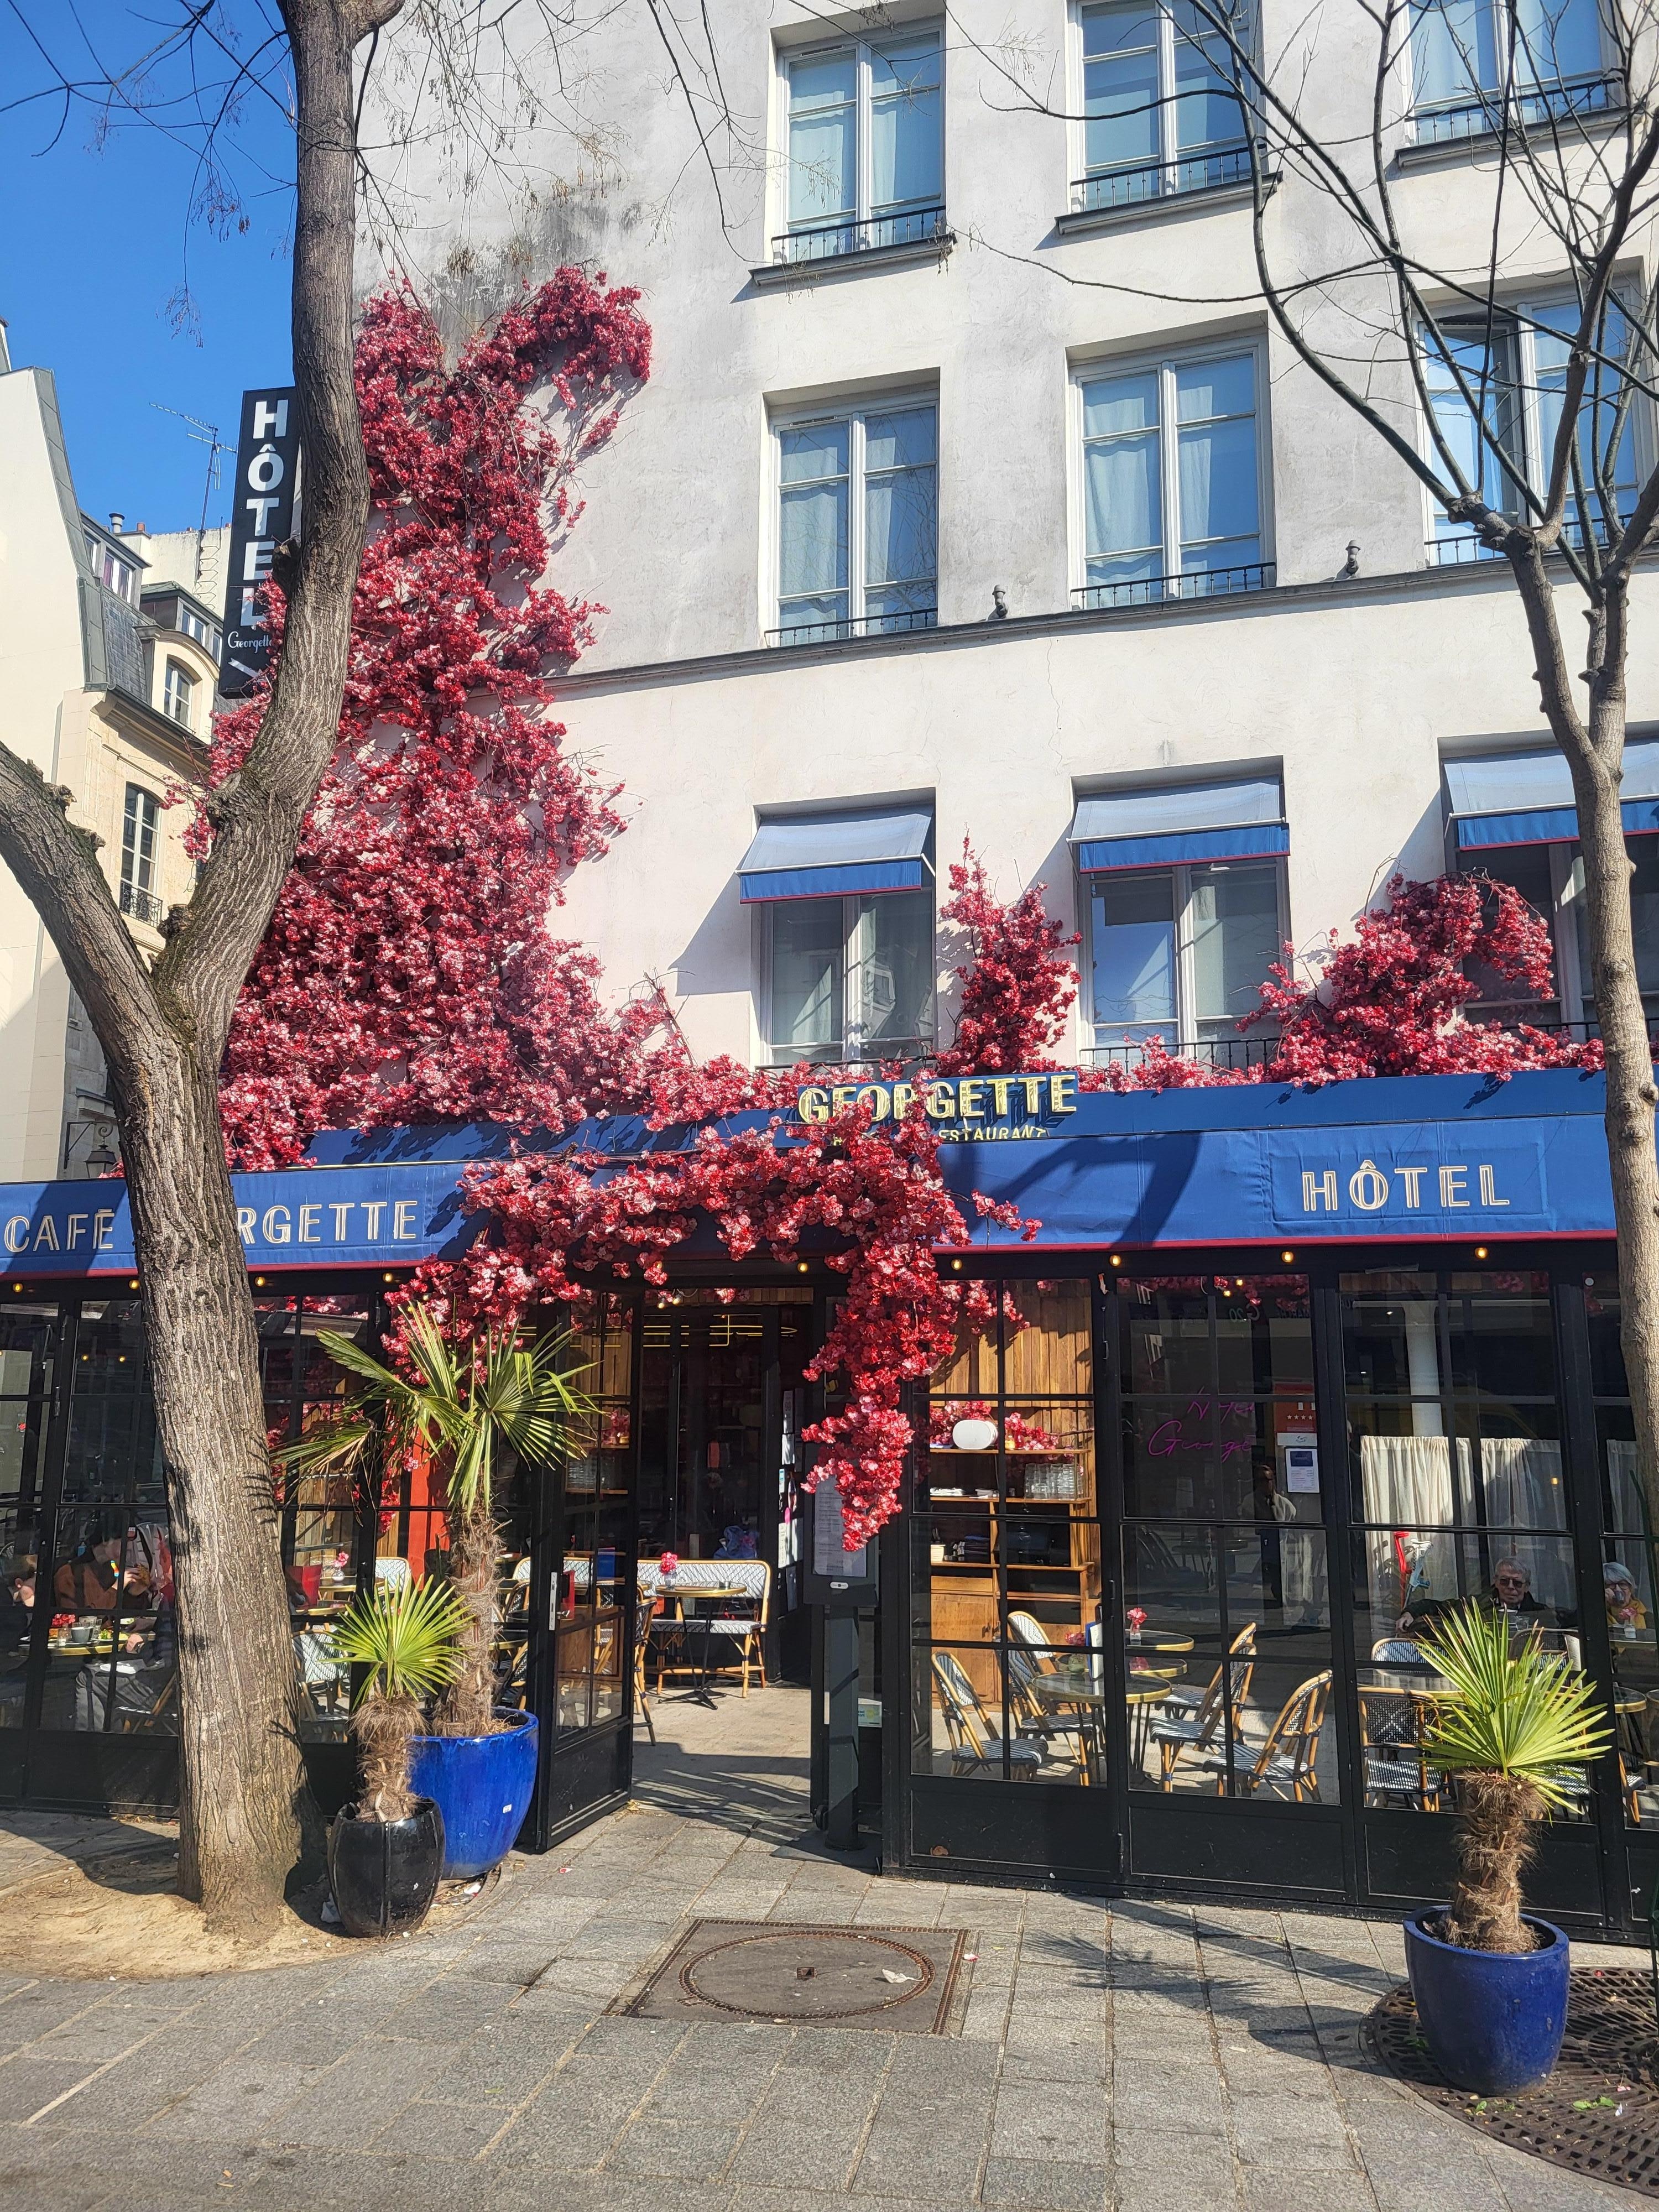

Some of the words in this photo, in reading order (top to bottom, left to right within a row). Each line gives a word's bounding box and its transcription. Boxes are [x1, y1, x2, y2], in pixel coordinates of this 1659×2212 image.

[240, 399, 288, 626] HÔTEL
[938, 1124, 1046, 1141] ESTAURANT
[1302, 1160, 1510, 1211] HÔTEL
